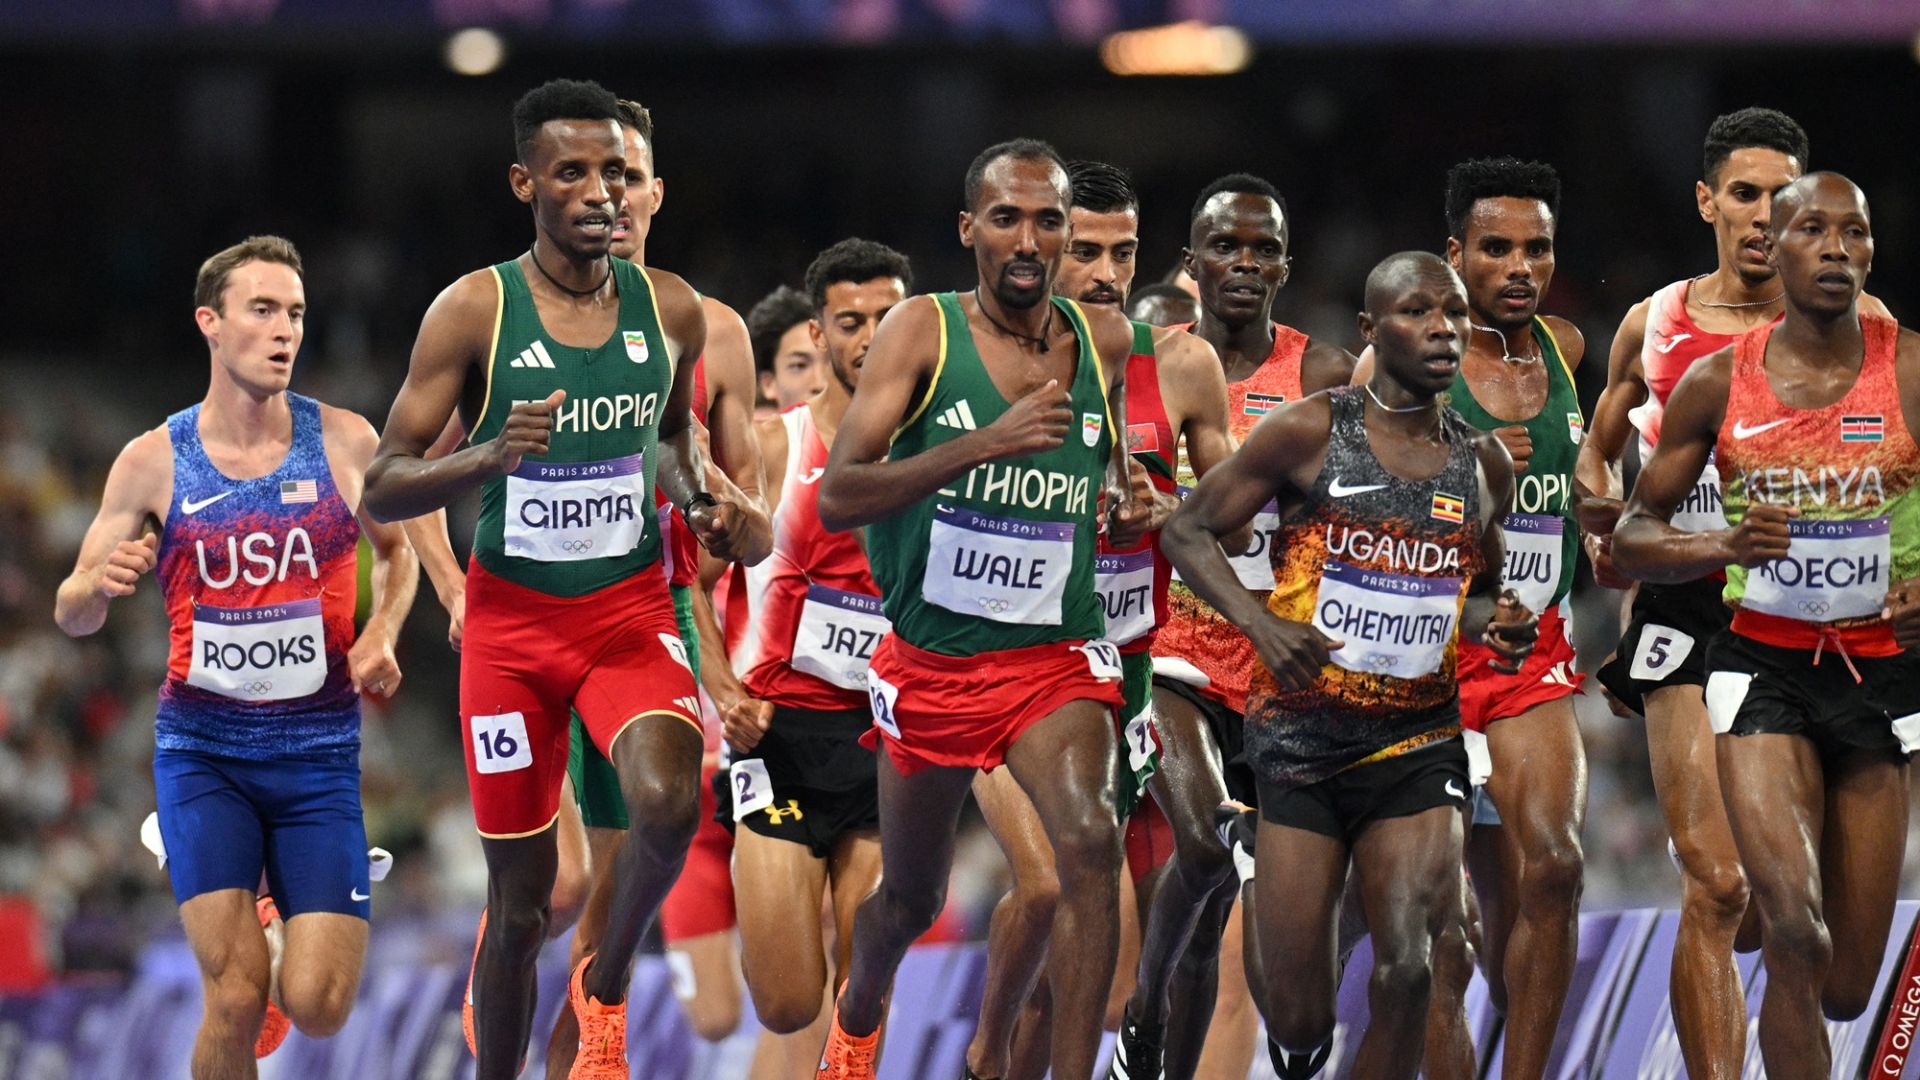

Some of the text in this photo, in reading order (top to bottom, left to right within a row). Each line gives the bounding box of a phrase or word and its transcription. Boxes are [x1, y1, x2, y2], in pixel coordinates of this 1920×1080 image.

[512, 392, 658, 433] HIOPIA
[541, 464, 614, 477] PARIS 2024
[1740, 465, 1886, 506] KENYA
[937, 463, 1089, 514] THIOPIA
[520, 493, 634, 529] GIRMA
[972, 516, 1044, 535] PARIS 2024
[1513, 518, 1540, 528] 2024
[1818, 525, 1852, 535] 2024
[195, 527, 319, 589] USA
[1095, 560, 1125, 568] 2024
[1326, 523, 1460, 573] UGANDA
[952, 547, 1047, 589] WALE
[1361, 574, 1432, 592] PARIS 2024
[219, 607, 287, 621] PARIS 2024
[842, 595, 876, 610] PARIS
[1320, 598, 1451, 645] CHEMUTAI
[203, 634, 316, 671] ROOKS
[1646, 636, 1672, 668] 5
[870, 686, 894, 726] 12
[478, 728, 518, 760] 16
[735, 771, 757, 804] 2
